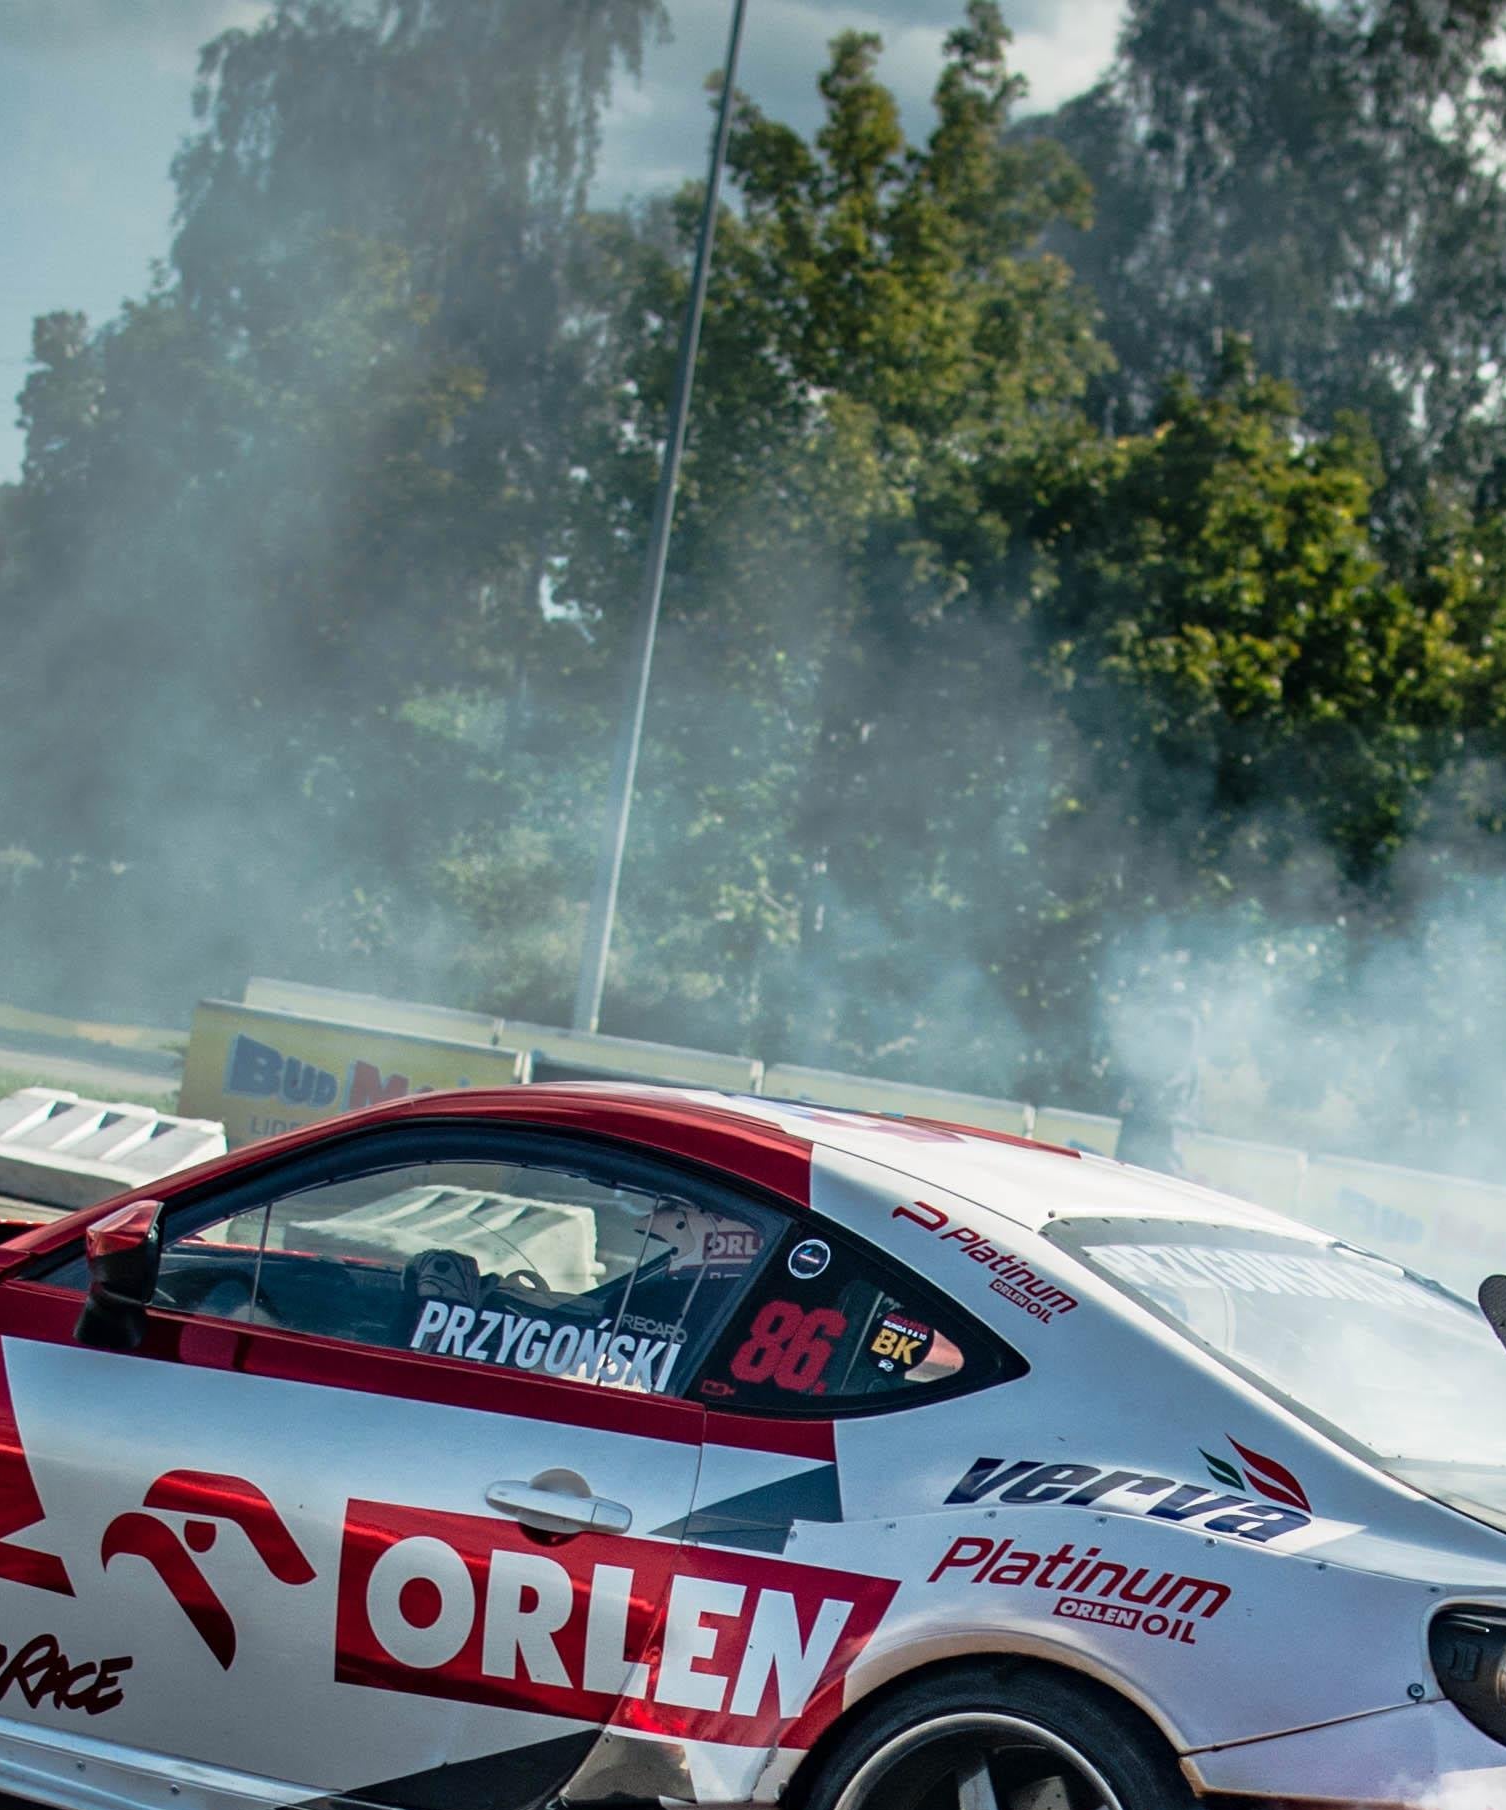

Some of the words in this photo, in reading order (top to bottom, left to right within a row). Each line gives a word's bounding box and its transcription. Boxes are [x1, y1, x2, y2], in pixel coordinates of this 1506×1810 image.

[939, 1227, 1079, 1315] Platinum
[409, 1300, 683, 1393] PRZYGOŃSKI
[621, 1313, 688, 1344] RECARO
[870, 1326, 923, 1366] BK
[941, 1456, 1313, 1543] verva
[926, 1536, 1232, 1619] Platinum
[366, 1535, 855, 1719] ORLEN
[1059, 1599, 1136, 1627] ORLEN
[1141, 1612, 1197, 1645] OIL
